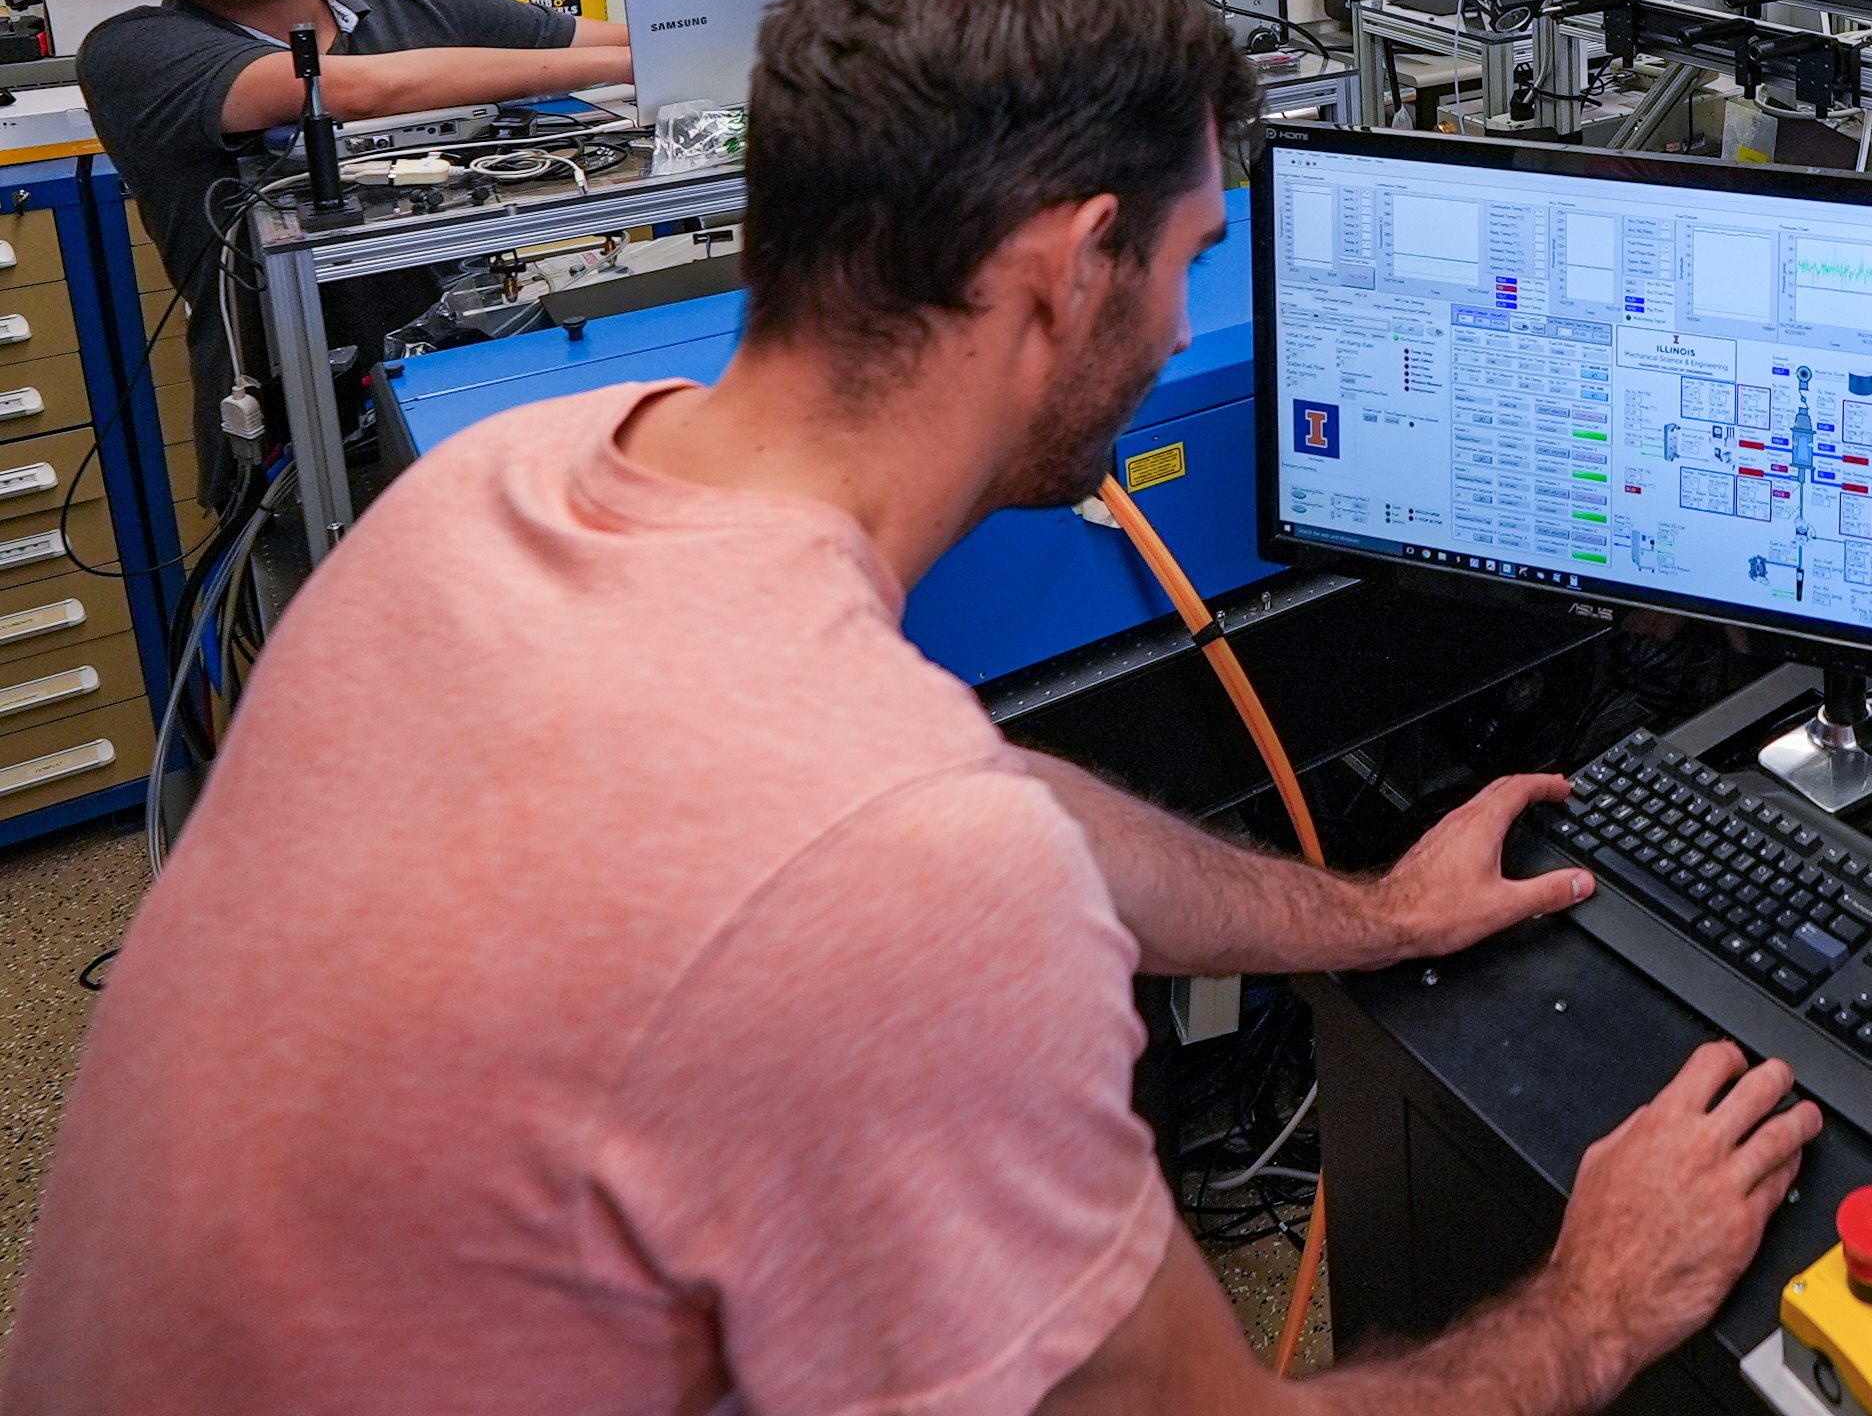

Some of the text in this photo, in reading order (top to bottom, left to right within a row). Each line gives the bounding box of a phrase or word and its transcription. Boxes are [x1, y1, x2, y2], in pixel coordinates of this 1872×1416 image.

[650, 16, 707, 32] SAMSUNG
[1279, 132, 1309, 141] HDMI
[1656, 345, 1696, 357] ILLINOIS
[1624, 350, 1658, 362] Mechanical
[1660, 355, 1684, 366] Science
[1690, 359, 1729, 372] Engineering
[1567, 602, 1614, 621] ASUS
